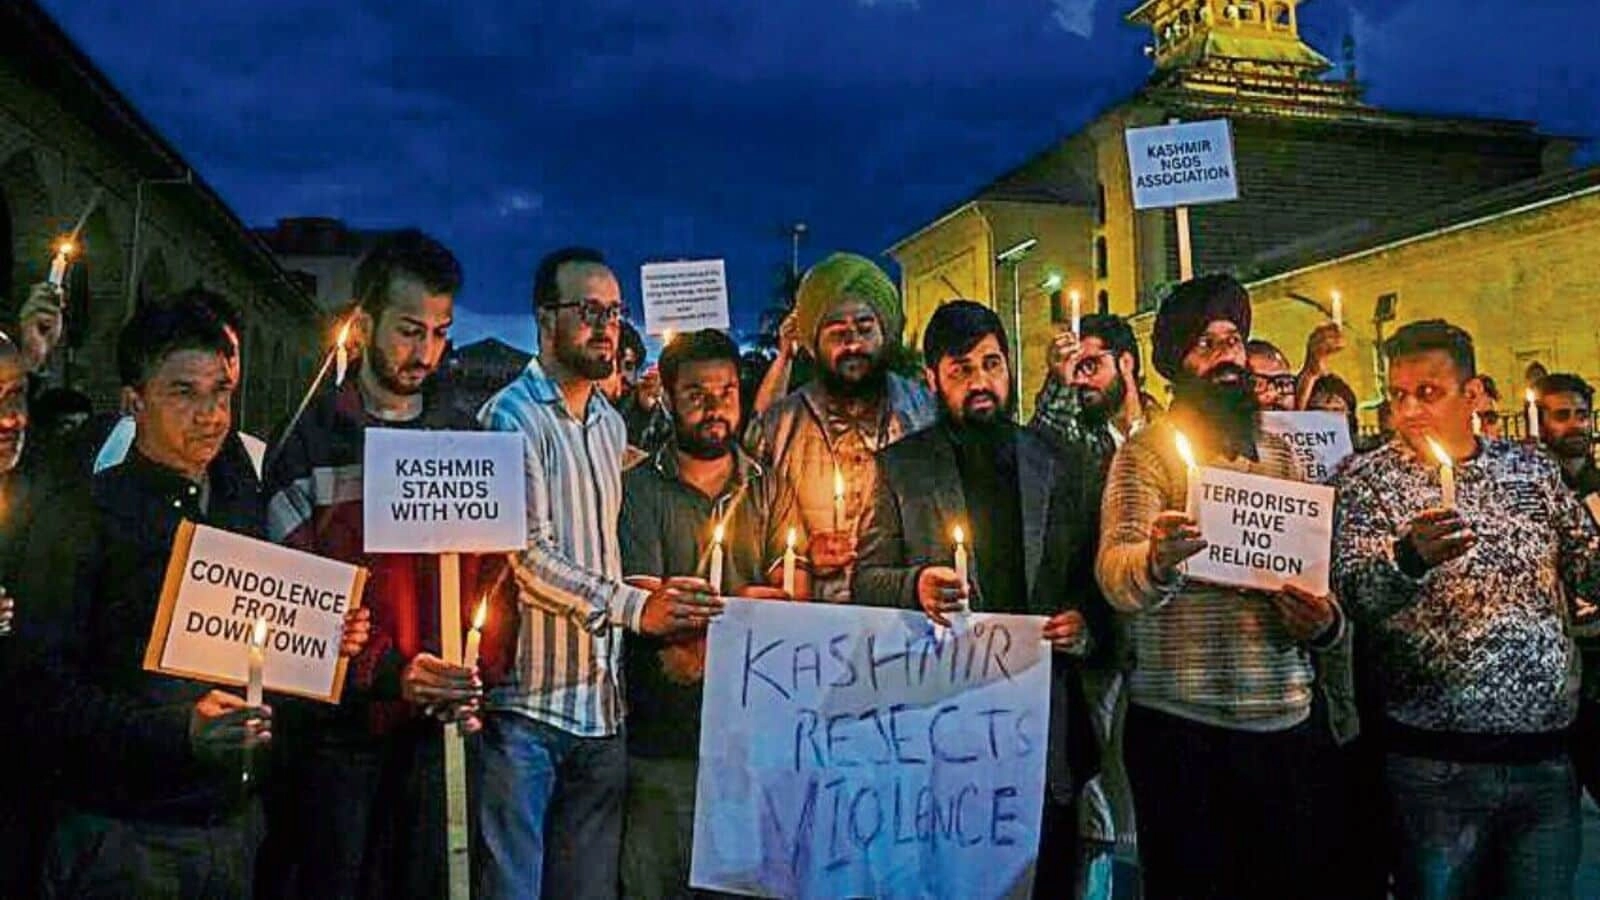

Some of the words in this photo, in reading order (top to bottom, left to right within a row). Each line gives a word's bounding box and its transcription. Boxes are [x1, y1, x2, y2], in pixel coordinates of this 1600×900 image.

[1147, 140, 1212, 158] KASHMIR
[1161, 156, 1202, 170] NGOS
[1136, 165, 1230, 188] ASSOCIATION
[1282, 431, 1336, 446] OCENT
[396, 459, 495, 477] KASHMIR
[402, 481, 488, 499] STANDS
[1202, 483, 1319, 517] TERRORISTS
[391, 502, 447, 521] WITH
[454, 502, 498, 520] YOU
[1232, 508, 1285, 532] HAVE
[1242, 530, 1271, 549] NO
[1209, 544, 1302, 575] RELIGION
[190, 560, 346, 614] CONDOLENCE
[232, 596, 297, 627] FROM
[795, 703, 1033, 772] REJECTS
